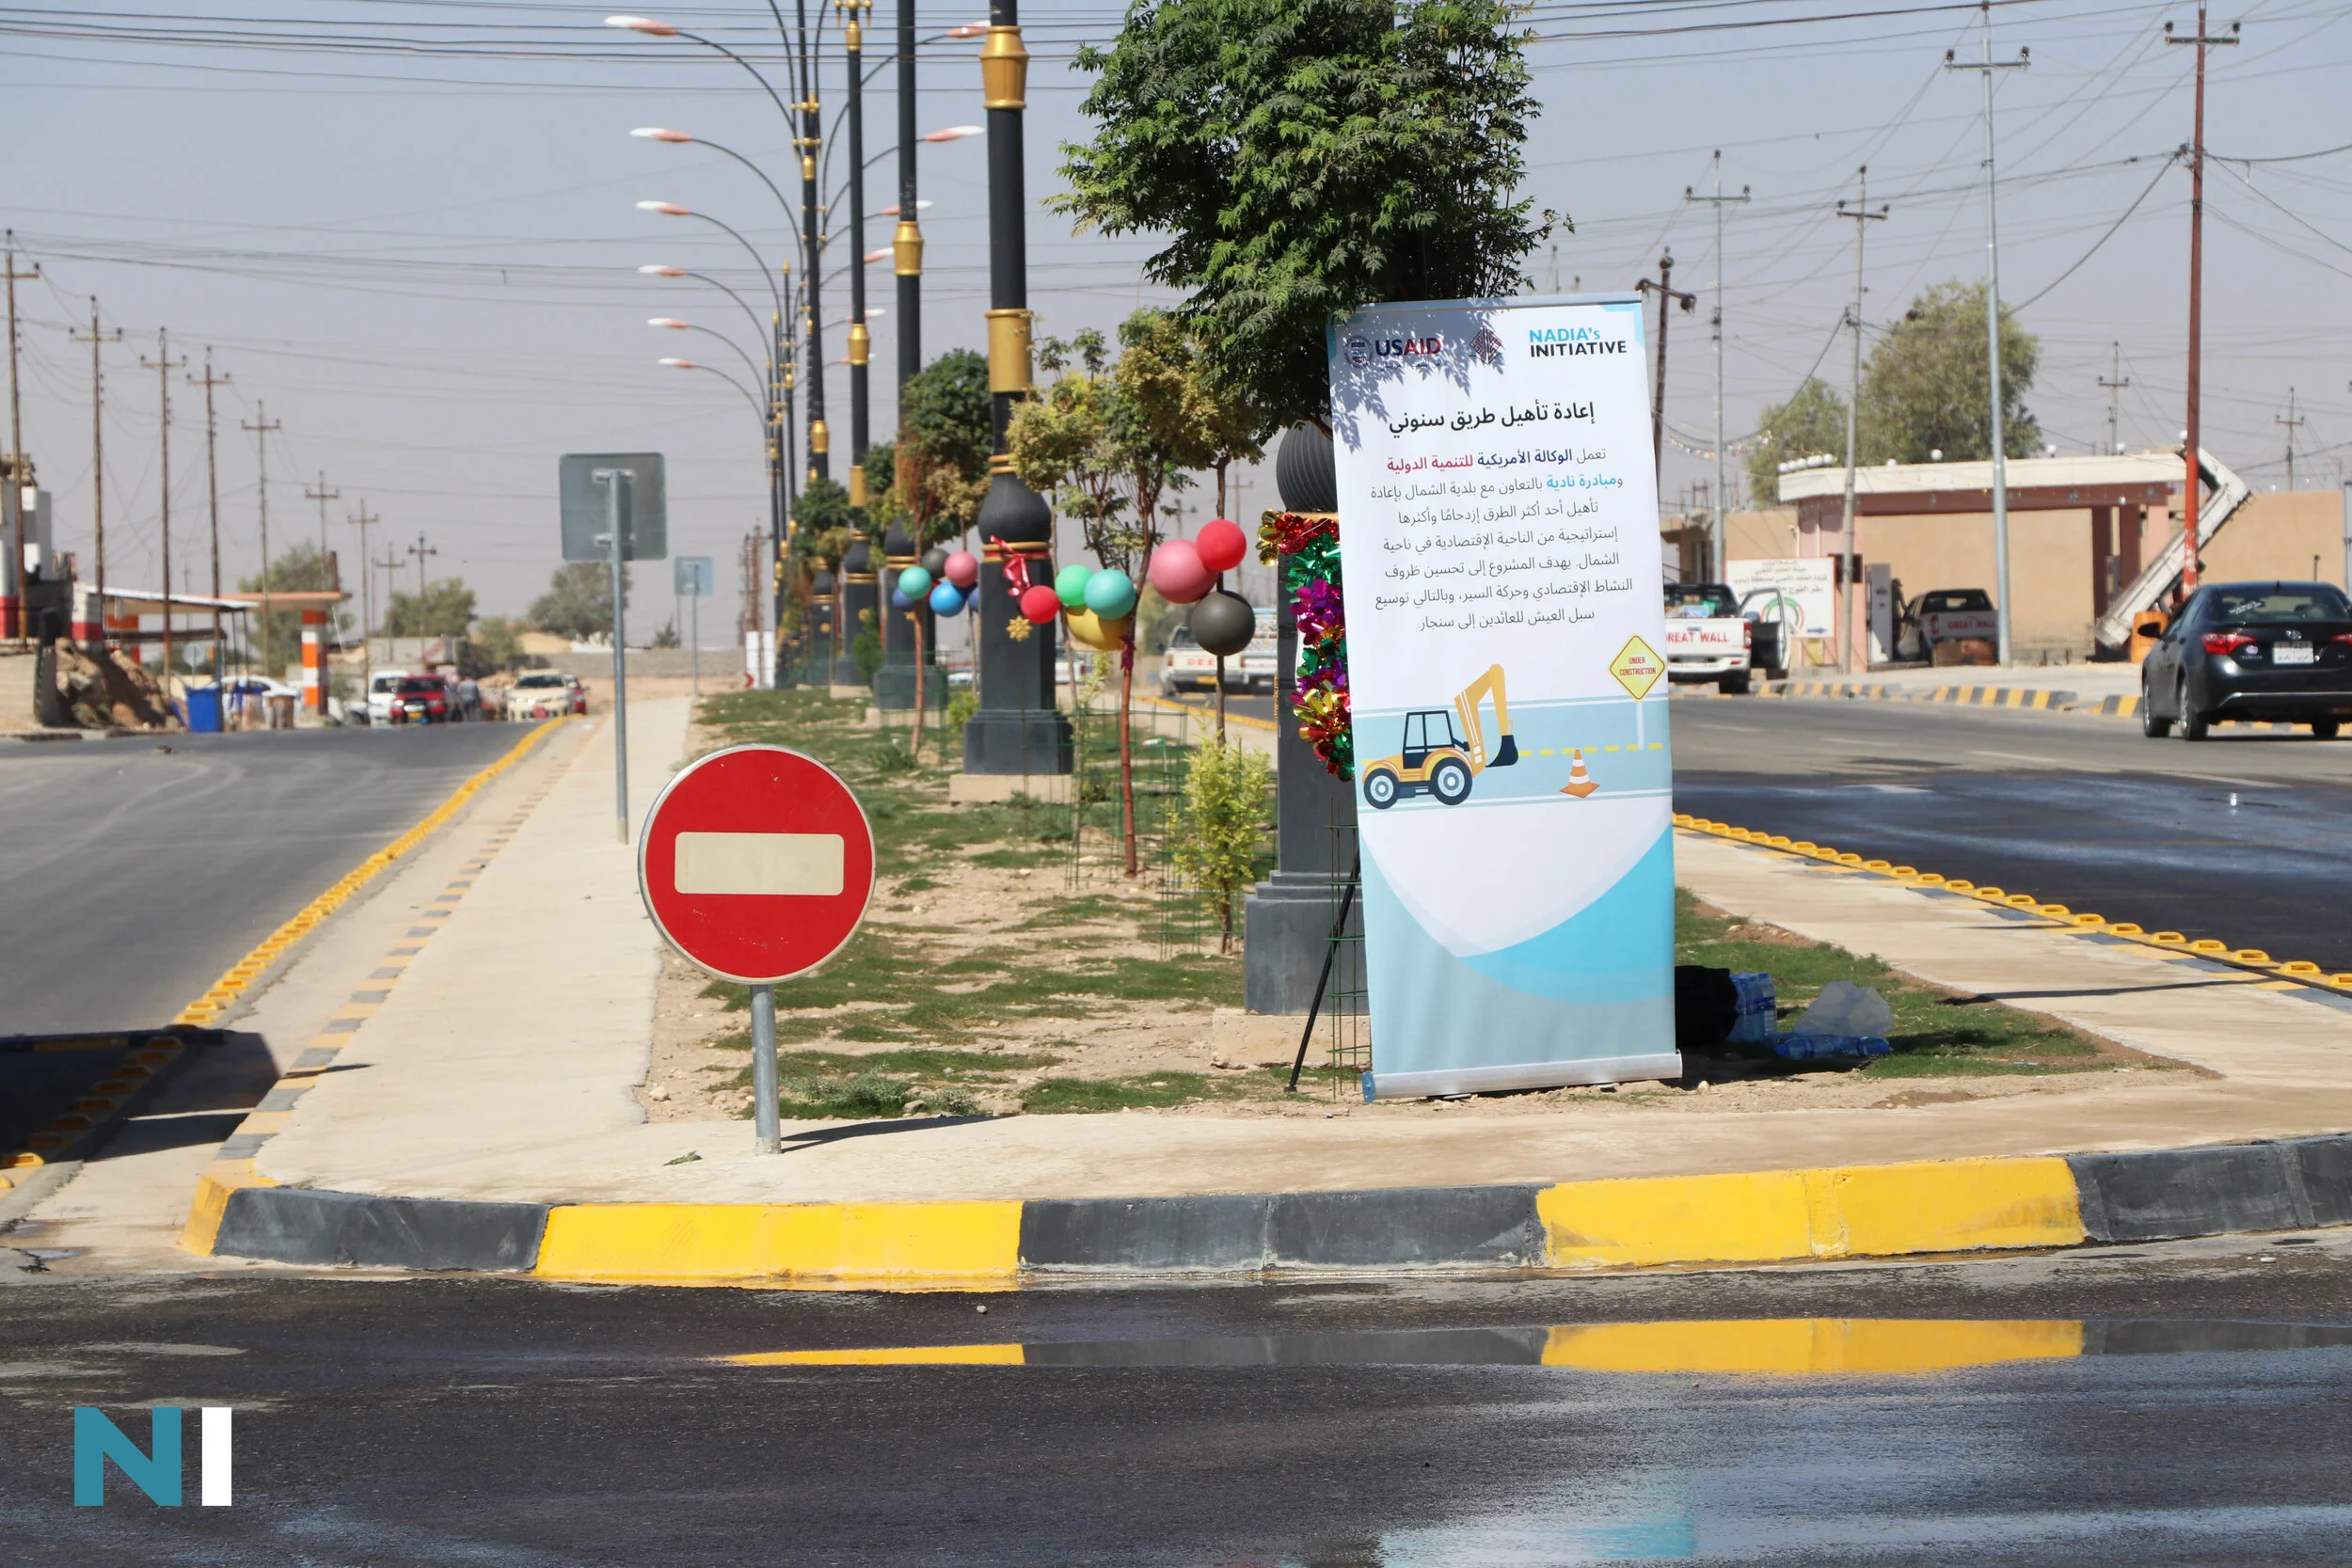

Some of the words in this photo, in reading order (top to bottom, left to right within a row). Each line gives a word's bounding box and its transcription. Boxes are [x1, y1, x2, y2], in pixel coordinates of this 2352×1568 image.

[1529, 327, 1601, 343] NADIA's
[1375, 338, 1441, 356] USAID
[1530, 341, 1628, 358] INITIATIVE
[1451, 407, 1495, 431] طريق
[1502, 399, 1548, 427] تأهيل
[1554, 402, 1596, 424] إعادة
[1389, 411, 1445, 437] سنوني
[1432, 454, 1473, 471] للتنمية
[1477, 449, 1531, 469] الأمريكية
[1534, 448, 1572, 465] الوكالة
[1577, 448, 1607, 464] تعمل
[1387, 456, 1428, 474] الدولية
[1450, 481, 1476, 497] بلدية
[1499, 477, 1543, 495] بالتعاون
[1547, 474, 1575, 492] نادية
[1579, 473, 1623, 489] ومبادرة
[1371, 484, 1402, 502] بإعادة
[1406, 482, 1447, 500] الشمال
[1480, 484, 1495, 499] مع
[1484, 505, 1517, 522] الطرق
[1520, 499, 1541, 519] أكثر
[1545, 499, 1564, 515] أحد
[1566, 497, 1598, 517] تأهيل
[1399, 506, 1438, 526] وأكثرها
[1436, 532, 1494, 550] الإقتصادية
[1498, 531, 1534, 547] الناحية
[1537, 532, 1555, 546] من
[1558, 525, 1618, 543] إستراتيجية
[1384, 537, 1411, 553] ناحية
[1415, 536, 1432, 555] في
[1385, 563, 1421, 580] ظروف
[1424, 562, 1465, 578] تحسين
[1468, 560, 1486, 577] إلى
[1489, 557, 1535, 578] المشروع
[1539, 556, 1571, 571] يهدف
[1496, 584, 1529, 600] وحركة
[1533, 580, 1591, 602] الإقتصادي
[1594, 578, 1633, 593] النشاط
[1375, 592, 1409, 610] توسيع
[1413, 588, 1454, 609] وبالتالي
[1458, 613, 1475, 629] إلى
[1479, 610, 1524, 628] للعائدين
[1528, 608, 1565, 626] العيش
[1568, 608, 1595, 624] سبل
[1666, 631, 1693, 643] REAT
[1700, 631, 1729, 643] WALL
[1619, 667, 1657, 676] CONSTRUCTION
